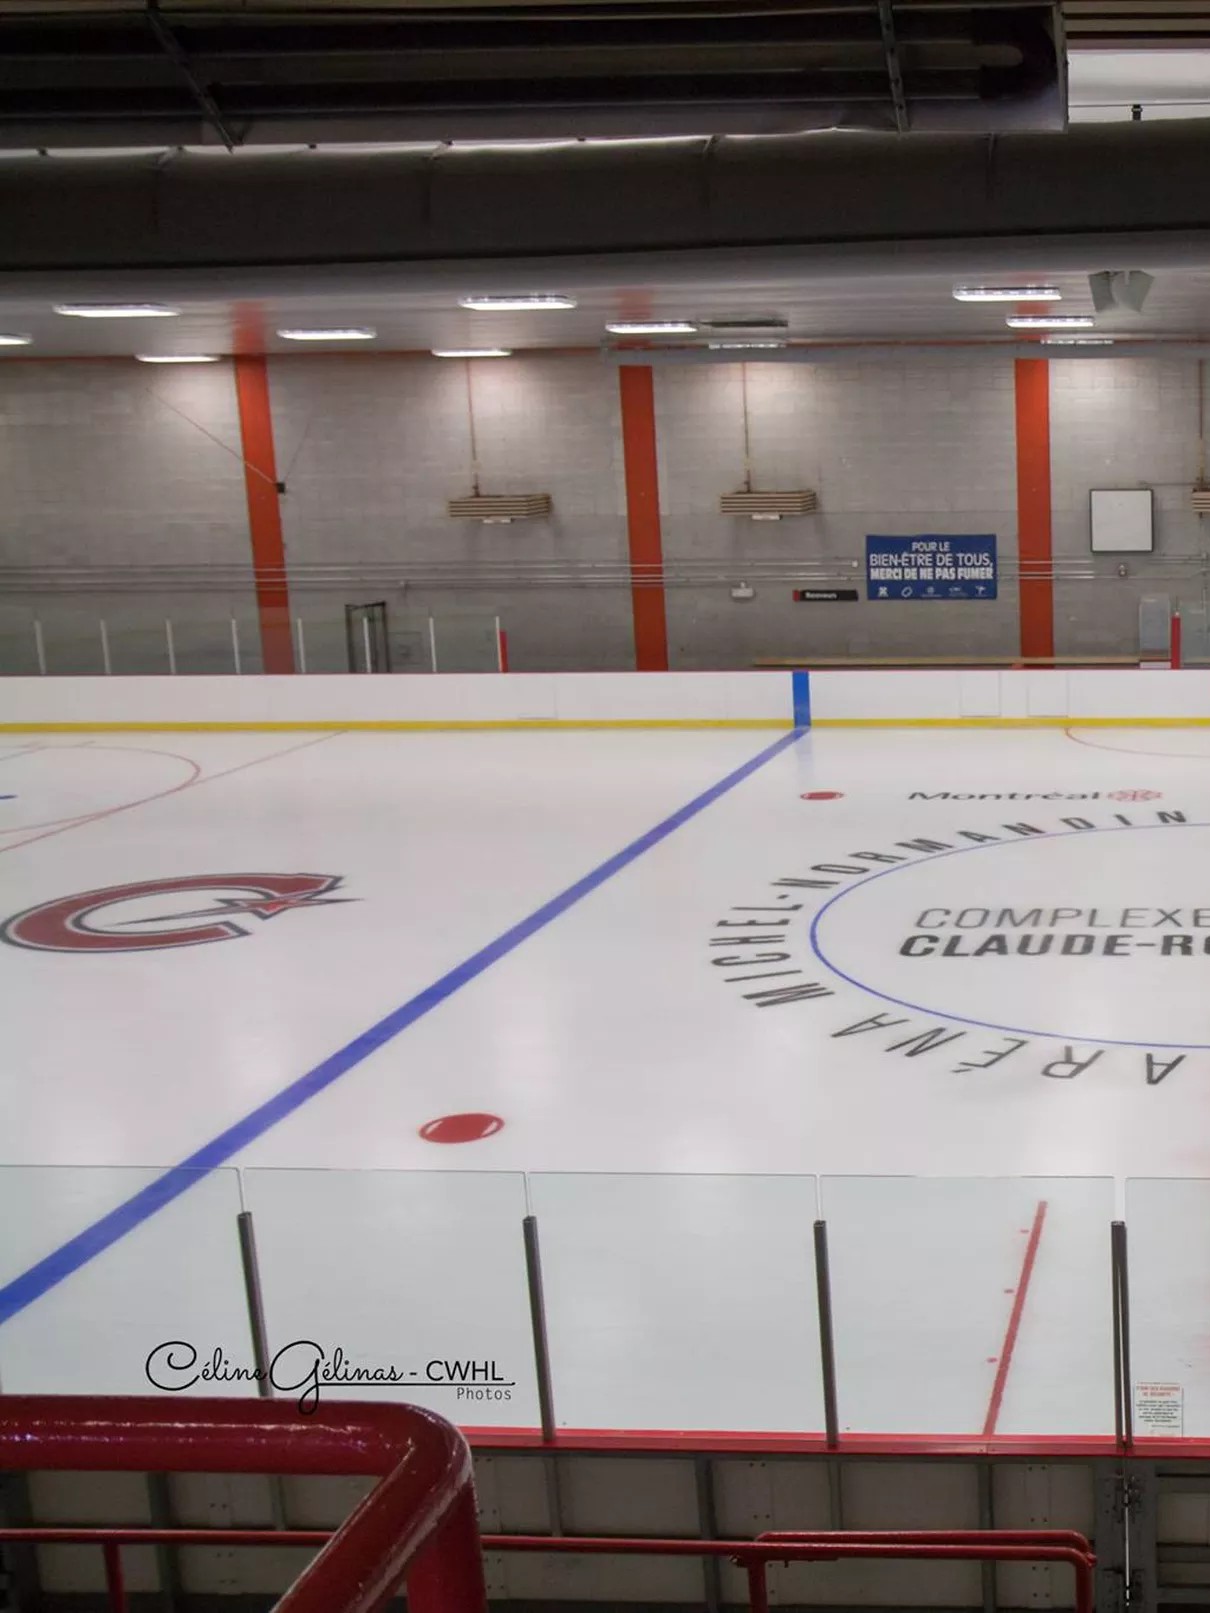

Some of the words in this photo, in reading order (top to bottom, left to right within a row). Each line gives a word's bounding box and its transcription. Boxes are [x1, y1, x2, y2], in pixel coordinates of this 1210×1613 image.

[911, 541, 936, 551] POUR
[938, 541, 951, 551] LE
[869, 552, 933, 567] BIEN-ÊTRE
[936, 553, 954, 566] DE
[956, 553, 994, 567] TOUS,
[870, 567, 903, 580] MERCI
[904, 567, 918, 579] DE
[919, 567, 934, 579] NE
[935, 567, 956, 579] PAS
[957, 567, 994, 579] FUMER
